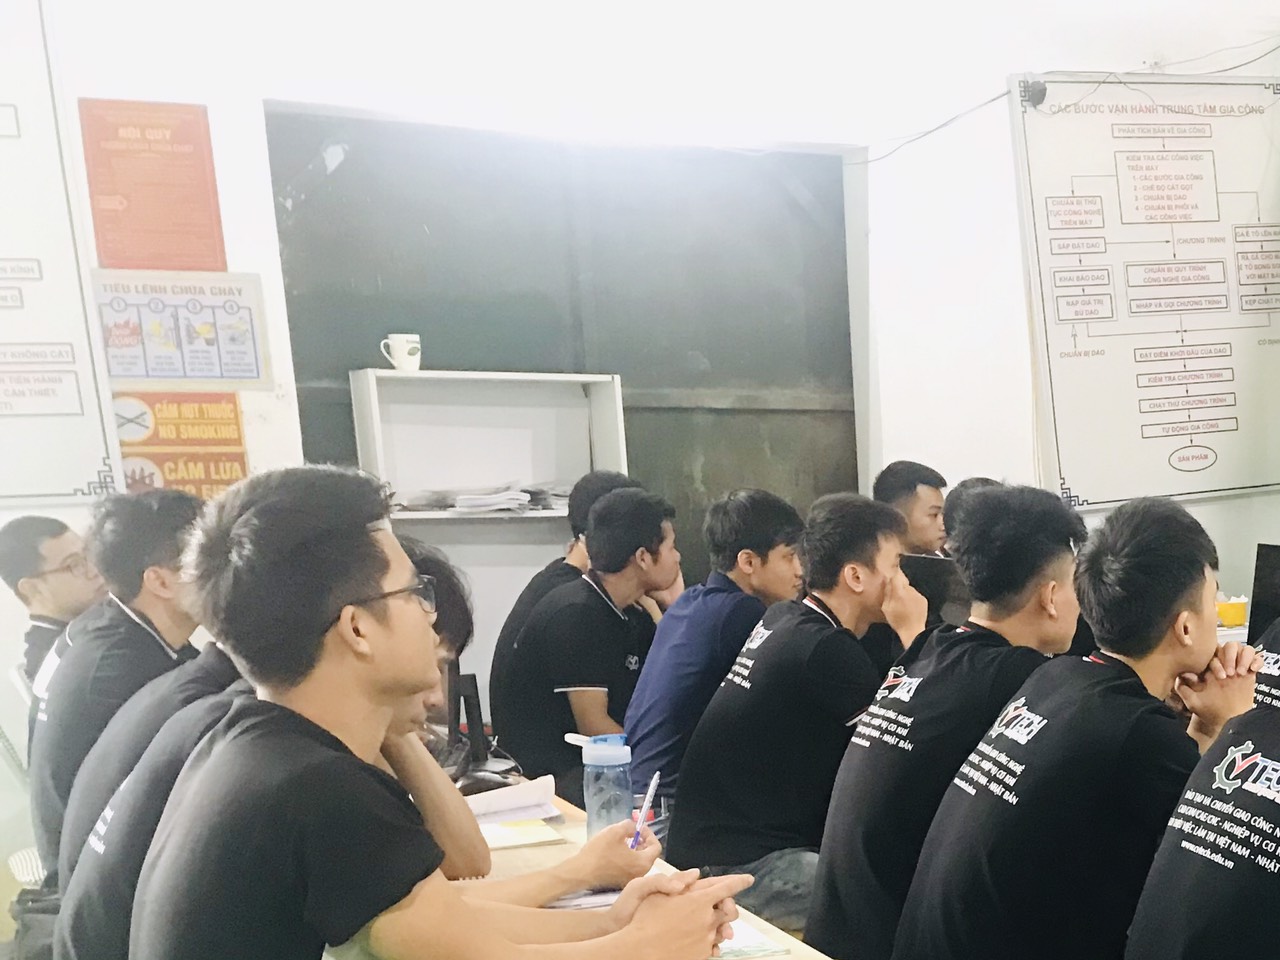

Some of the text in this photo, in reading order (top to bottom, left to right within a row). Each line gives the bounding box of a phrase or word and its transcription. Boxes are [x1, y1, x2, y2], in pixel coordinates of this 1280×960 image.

[1050, 103, 1265, 116] CÁC BƯỚC VẬN HÀNH TRUNG TÂM GIA CÔNG
[159, 424, 239, 439] NO SMOKING
[163, 456, 243, 480] CẤM LỬA
[1232, 808, 1252, 822] GIAO
[1250, 816, 1274, 834] CÔNG
[1215, 834, 1232, 849] VIỆT
[1230, 841, 1251, 859] NAM
[1221, 820, 1251, 839] NGHIỆP
[1249, 828, 1262, 847] VỤ
[1262, 840, 1275, 852] CƠ
